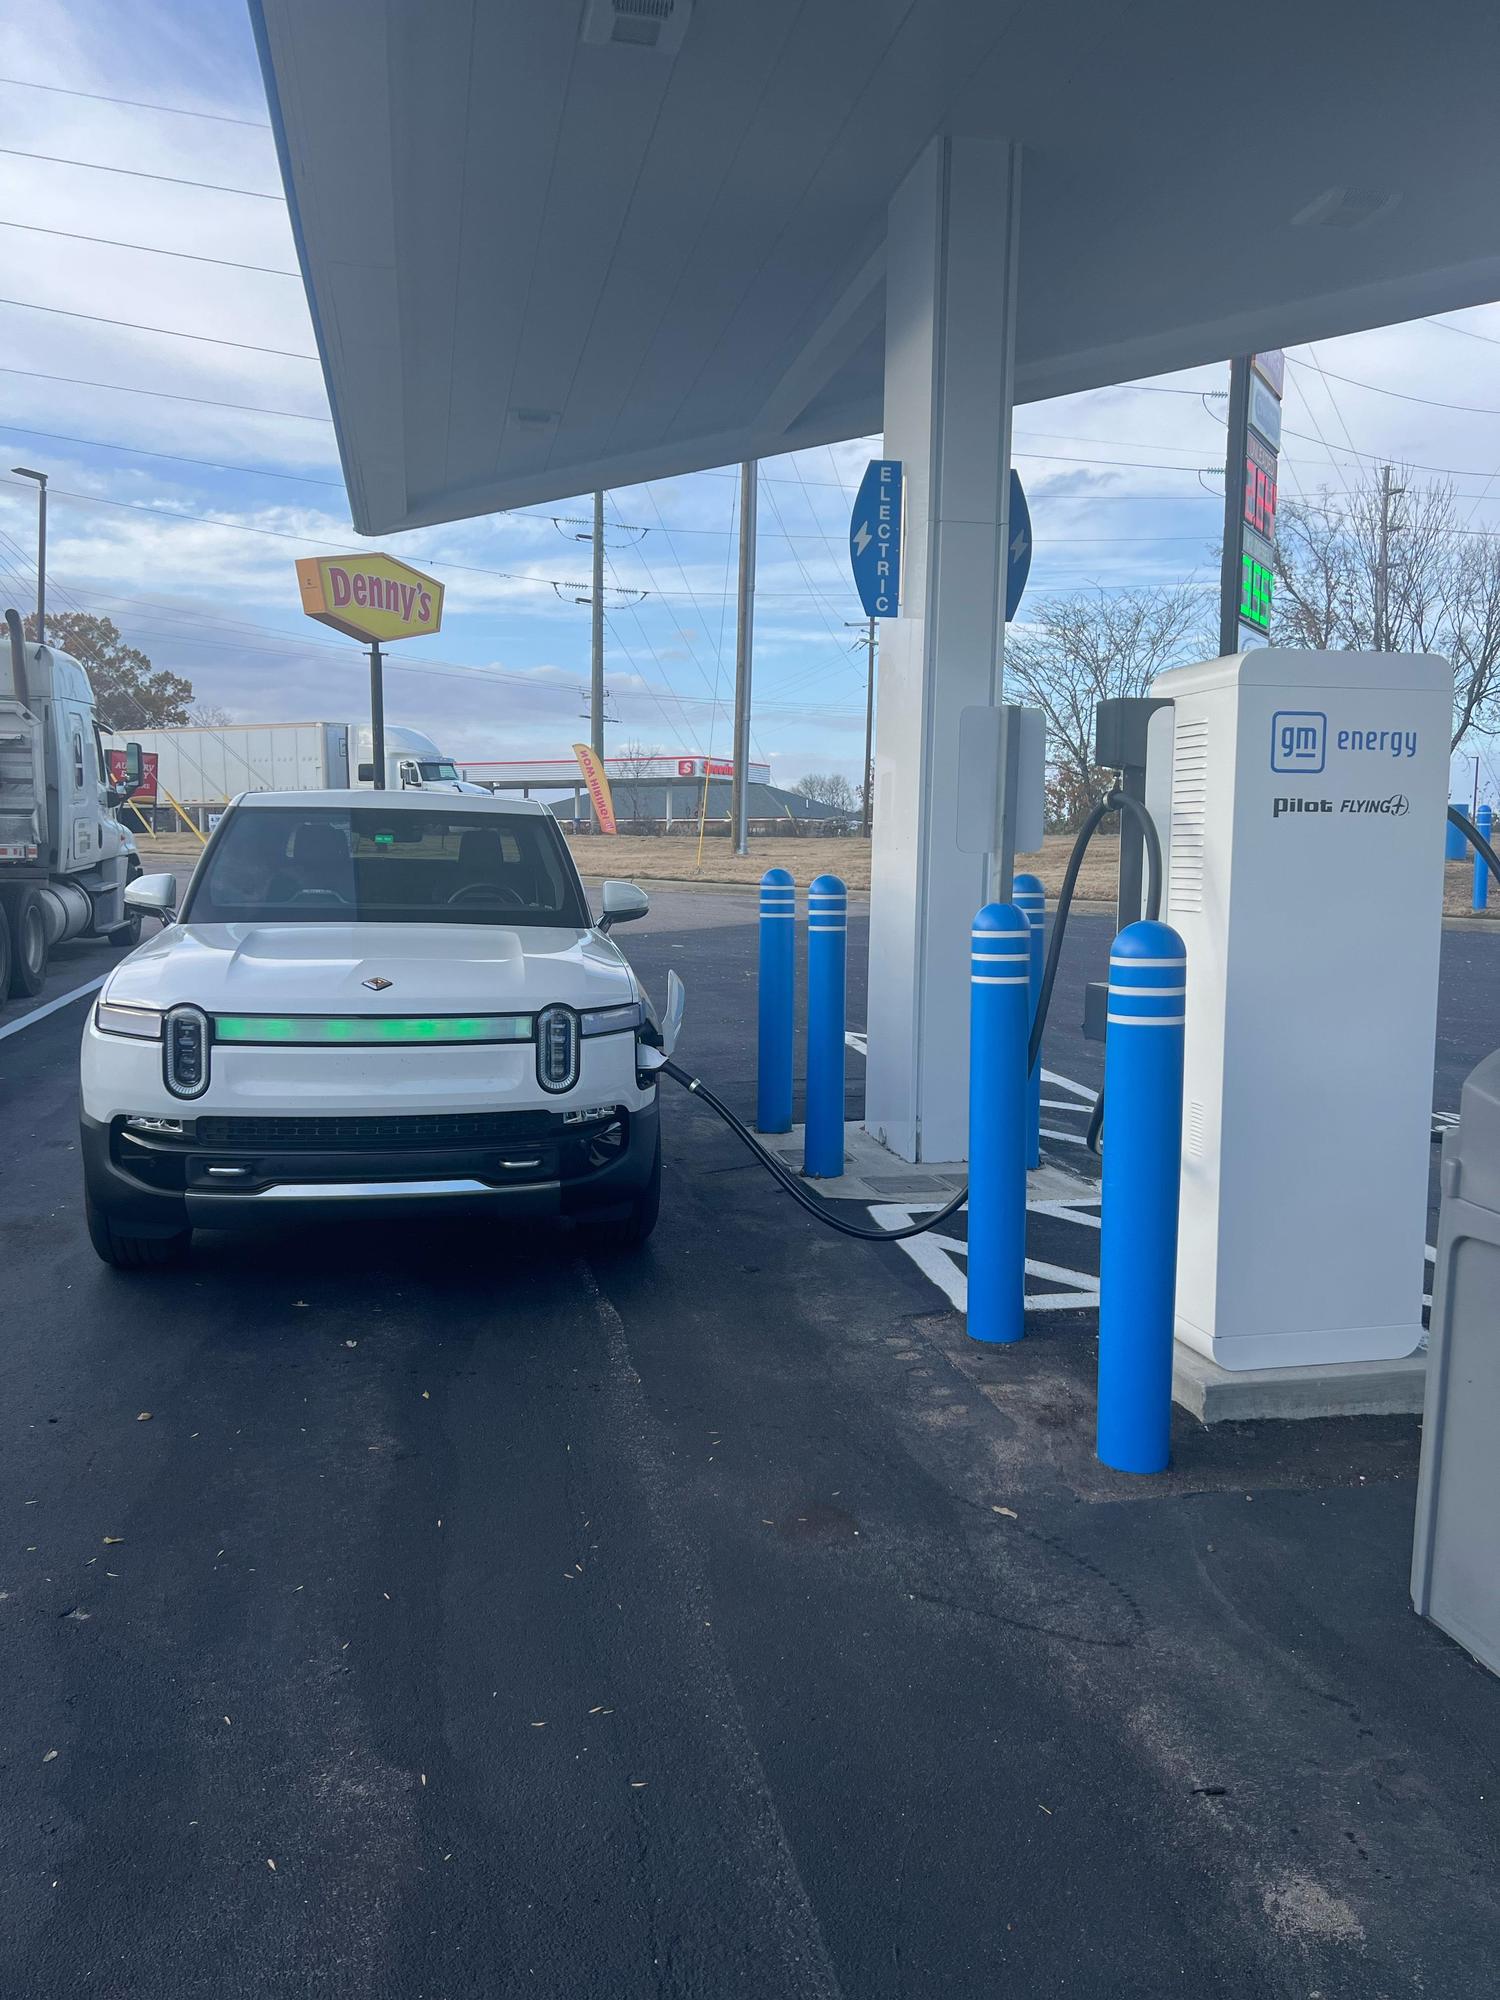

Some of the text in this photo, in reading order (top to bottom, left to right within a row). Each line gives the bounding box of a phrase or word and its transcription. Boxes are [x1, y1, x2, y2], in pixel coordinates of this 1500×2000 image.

[875, 466, 892, 612] ELECTRIC
[328, 567, 432, 623] Denny's
[1281, 726, 1417, 758] gm energy
[1273, 798, 1333, 818] Pilot
